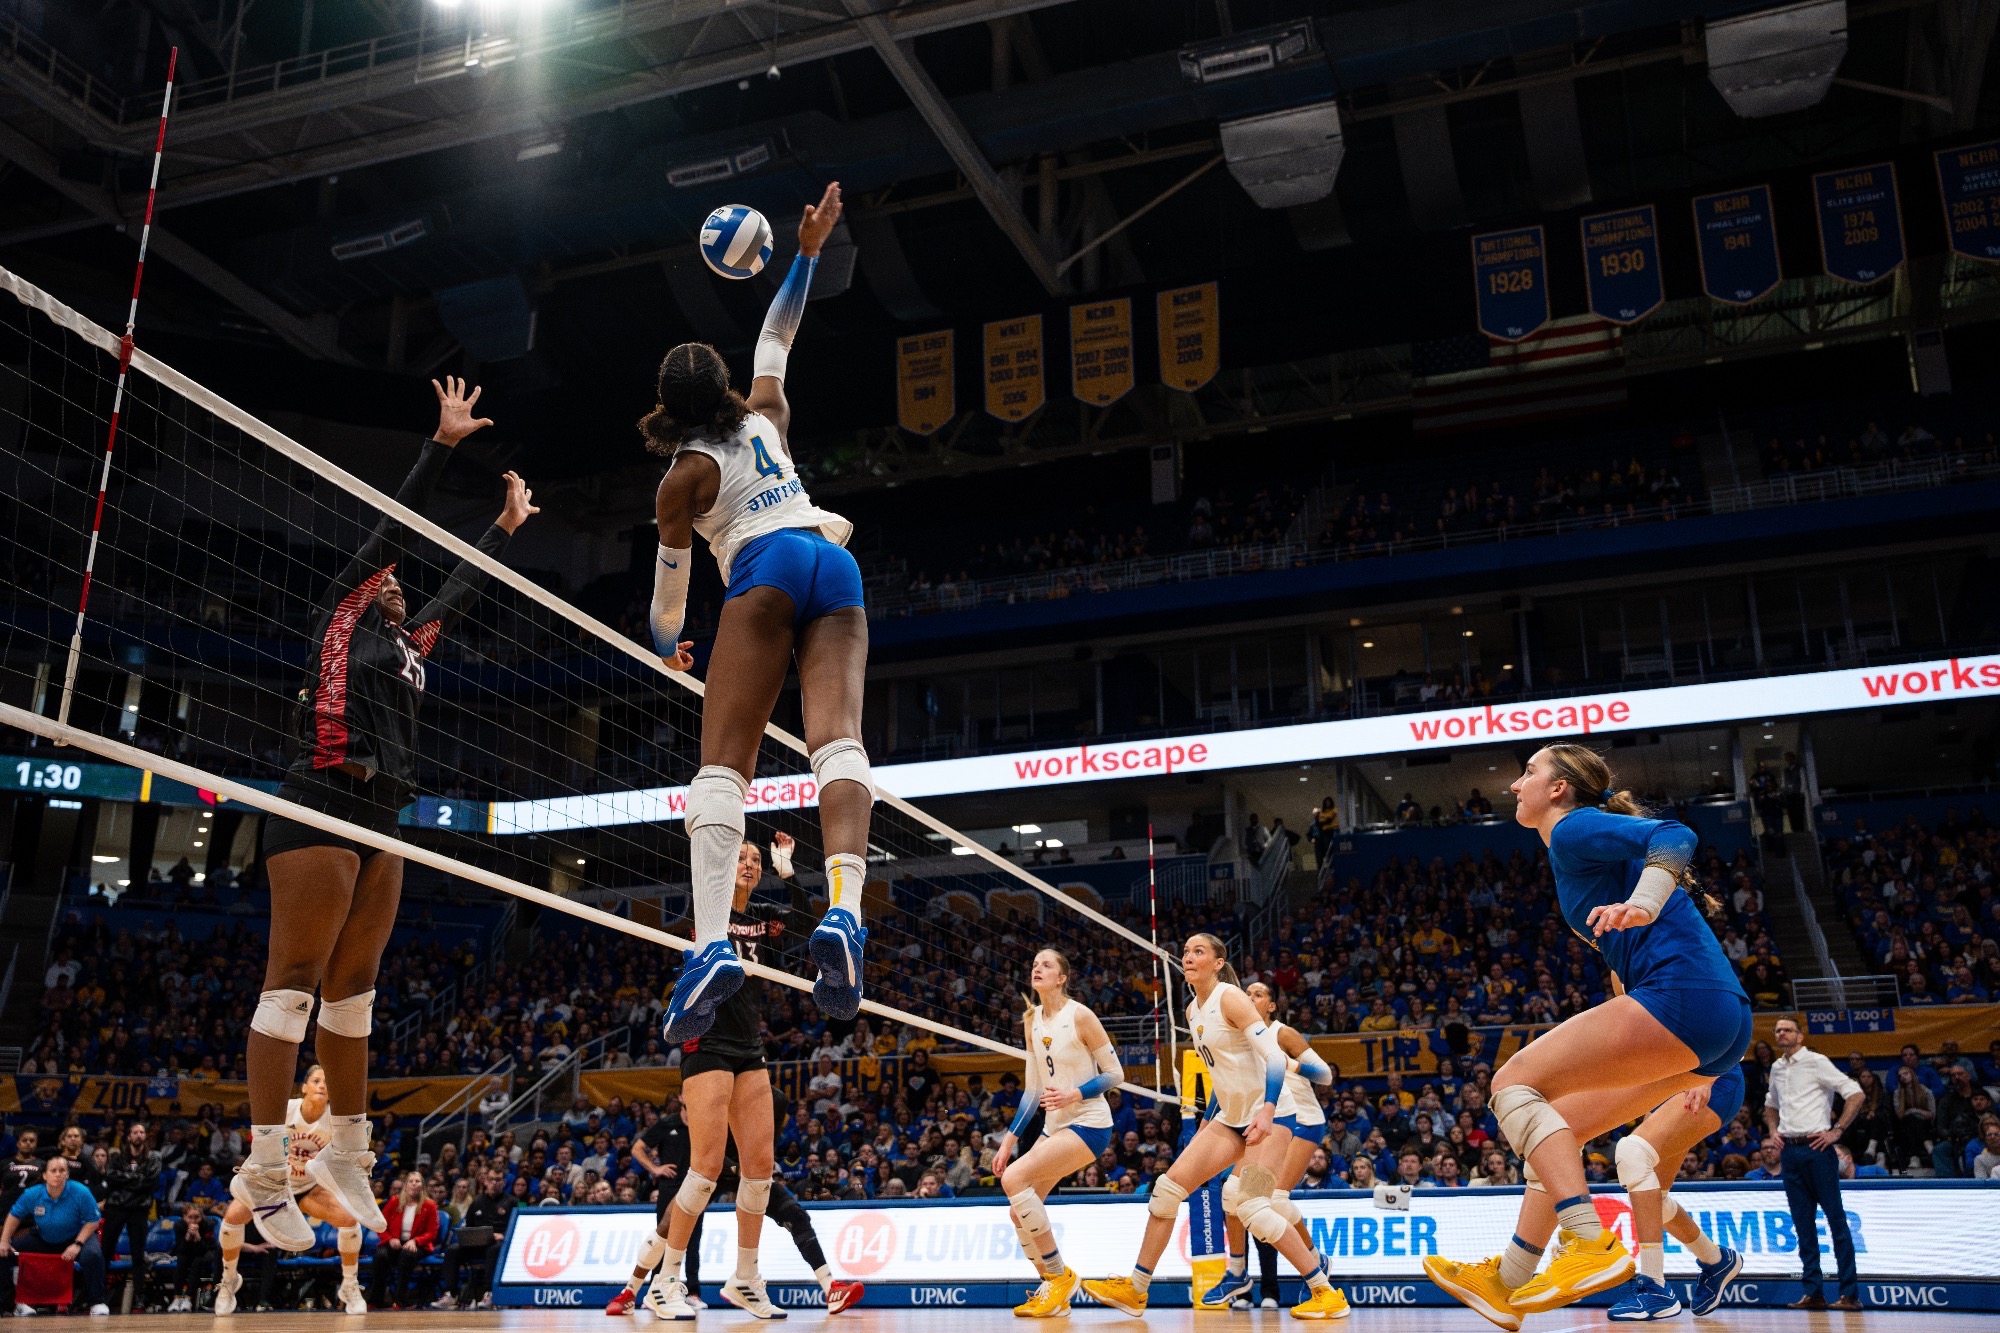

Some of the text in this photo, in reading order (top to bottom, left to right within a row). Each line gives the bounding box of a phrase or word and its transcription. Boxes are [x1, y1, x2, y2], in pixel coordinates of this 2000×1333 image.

[1590, 214, 1643, 232] NATIONAL
[1707, 214, 1762, 230] FINAL FOUR
[1842, 210, 1875, 229] 1974
[1480, 235, 1533, 251] NATIONAL
[1586, 225, 1652, 247] CHAMPIONS
[1723, 233, 1752, 250] 1941
[1844, 226, 1879, 246] 2009
[1478, 247, 1540, 265] CHAMPIONS
[1600, 249, 1645, 277] 1930
[1488, 269, 1533, 296] 1928
[750, 434, 786, 481] 4
[1409, 700, 1630, 741] workscape
[1014, 742, 1209, 782] workscape
[17, 761, 85, 791] 1:30
[667, 780, 816, 813] wscap
[438, 806, 453, 826] 2
[1811, 1011, 1846, 1023] ZOO E
[1854, 1010, 1890, 1021] ZOO F
[1046, 1055, 1055, 1077] 9
[1198, 1044, 1215, 1068] 10
[94, 1082, 148, 1110] ZOO
[1201, 1189, 1212, 1255] sports imports
[527, 1229, 574, 1267] 84
[839, 1225, 890, 1264] 84
[534, 1288, 583, 1306] UPMC
[910, 1287, 967, 1305] UPMC
[1351, 1286, 1416, 1305] UPMC
[1868, 1285, 1949, 1307] UPMC
